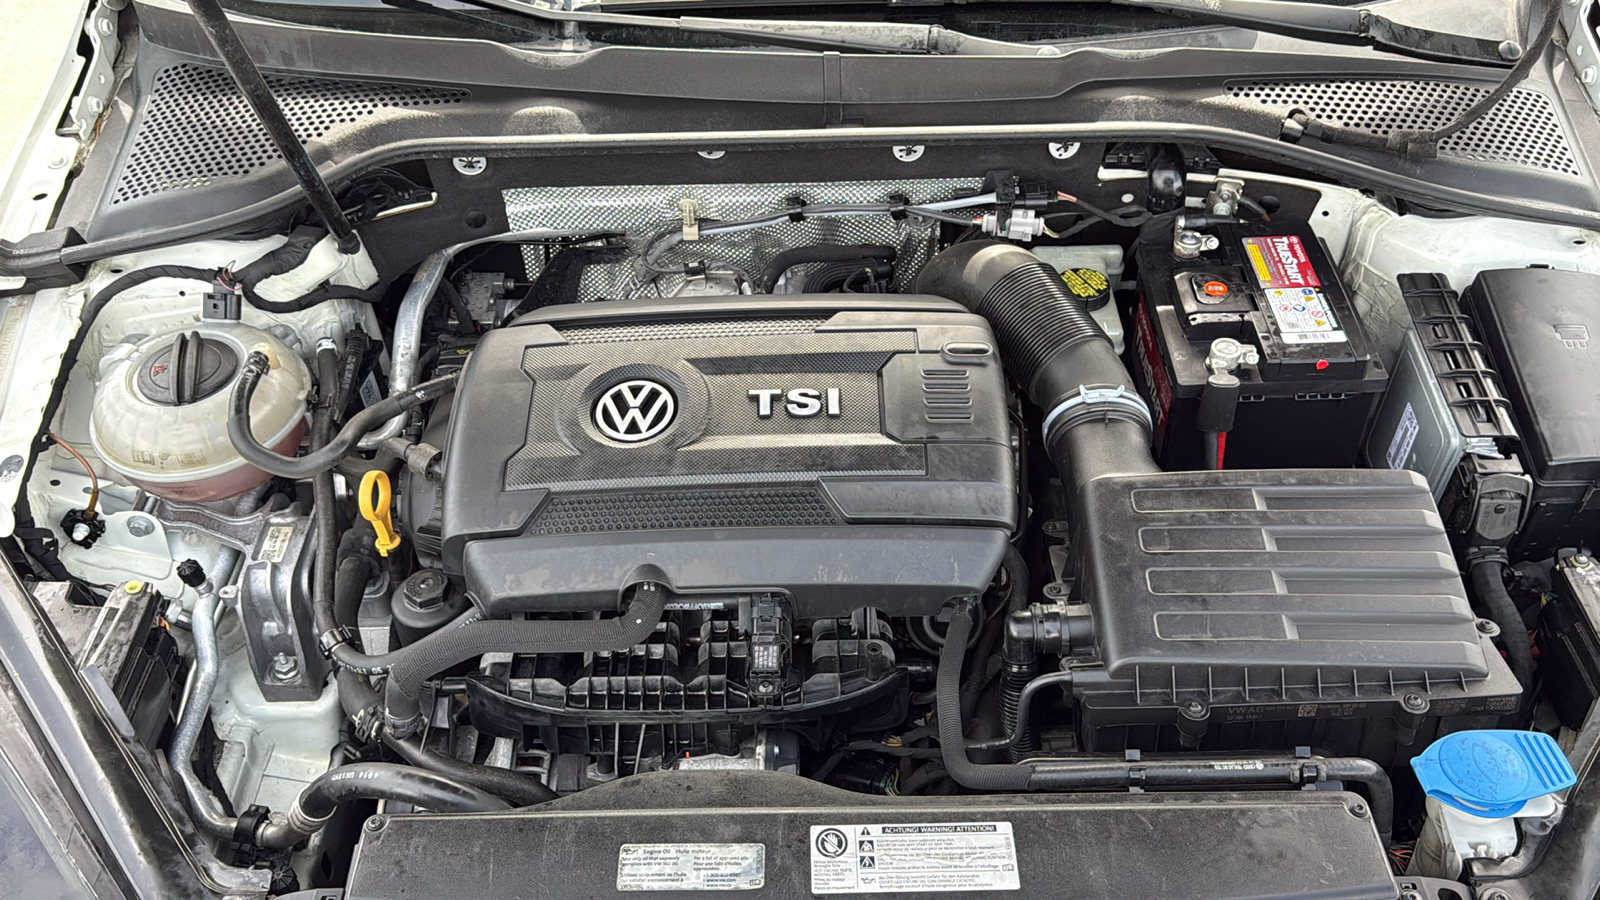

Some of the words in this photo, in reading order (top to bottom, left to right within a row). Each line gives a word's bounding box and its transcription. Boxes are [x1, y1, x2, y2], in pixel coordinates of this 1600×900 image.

[1272, 236, 1305, 286] TRUESTART
[1293, 243, 1306, 264] TOYOTA
[748, 387, 841, 417] TSI
